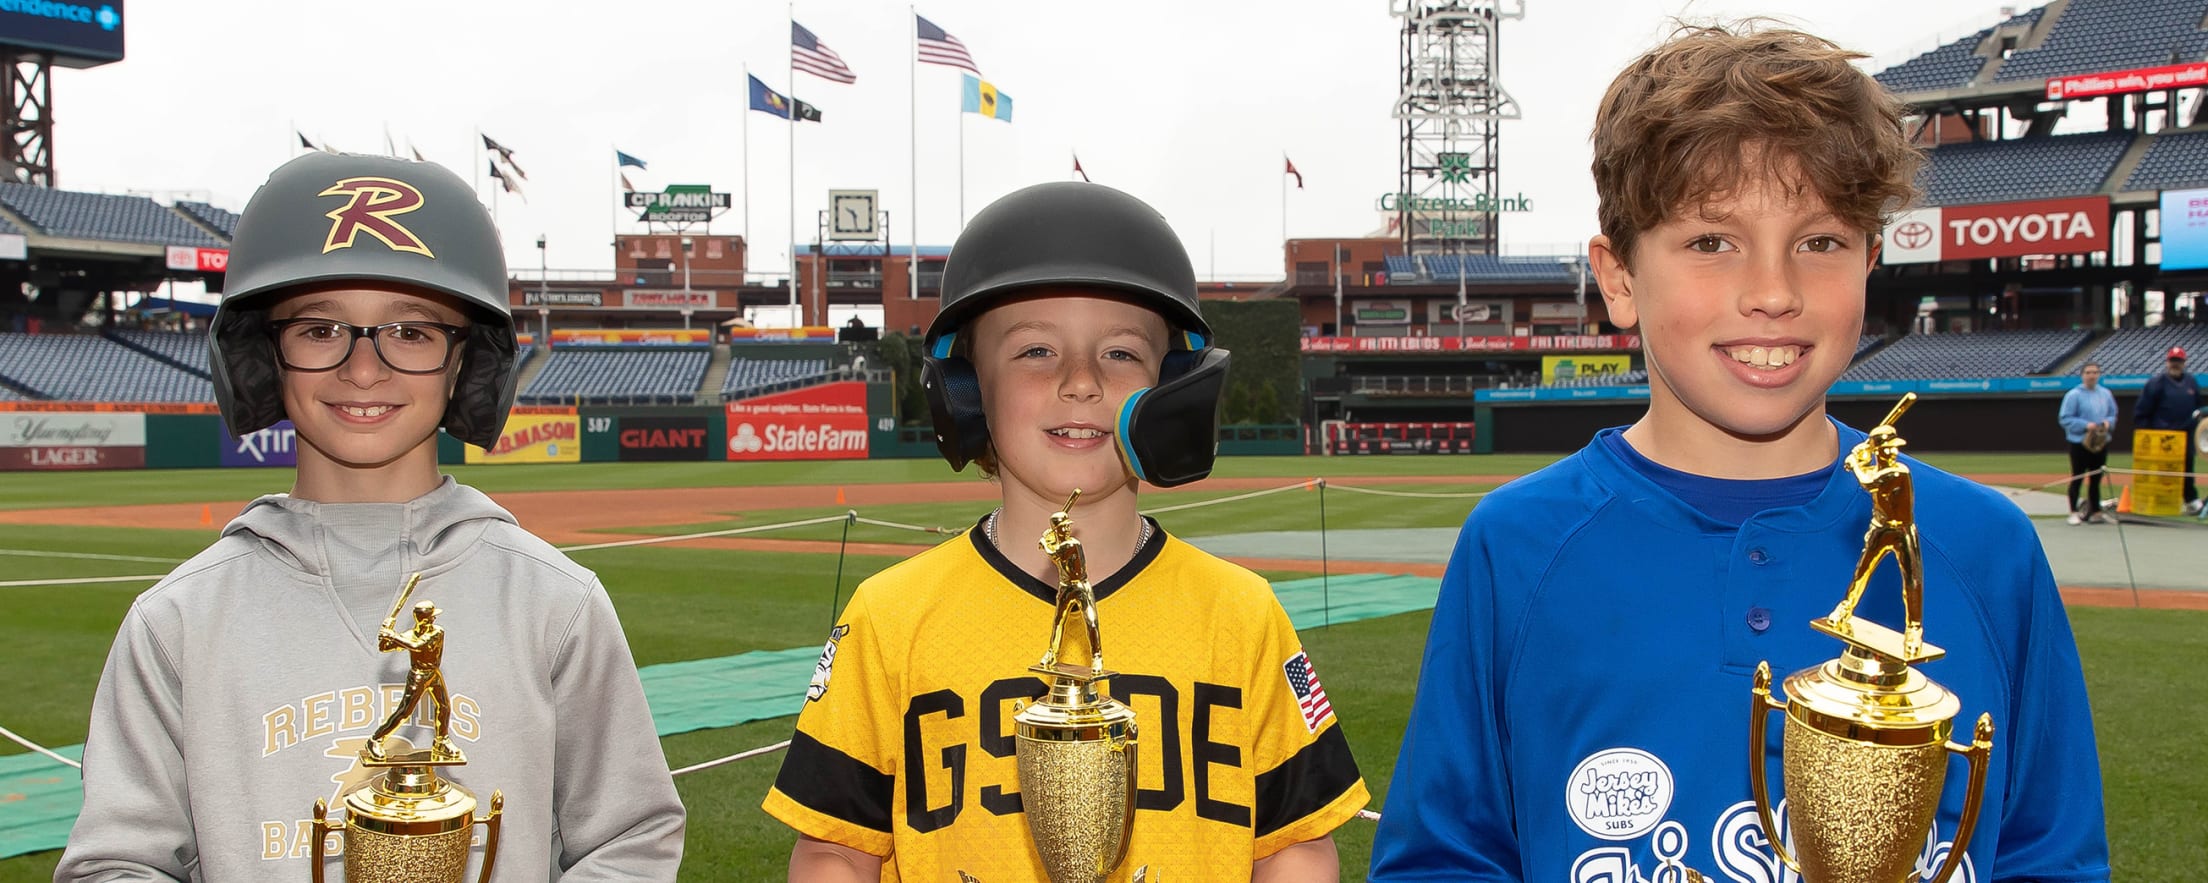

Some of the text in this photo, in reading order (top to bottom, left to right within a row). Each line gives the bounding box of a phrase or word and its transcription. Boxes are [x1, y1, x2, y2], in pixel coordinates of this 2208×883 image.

[2064, 77, 2115, 93] Phillies
[2147, 73, 2174, 88] you
[631, 193, 724, 207] CP RANKIN
[1381, 191, 1529, 211] Citizens Bank
[317, 176, 435, 259] R
[1431, 217, 1479, 237] Park
[1949, 211, 2095, 247] TOYOTA
[1582, 363, 1618, 373] PLAY
[587, 417, 611, 433] 387
[237, 429, 296, 462] xfin
[620, 429, 706, 448] GIANT
[31, 449, 98, 465] LAGER
[904, 674, 1251, 834] GSDE
[1580, 768, 1658, 796] Jersey
[1586, 789, 1657, 819] Mike's
[1605, 820, 1634, 830] SUBS
